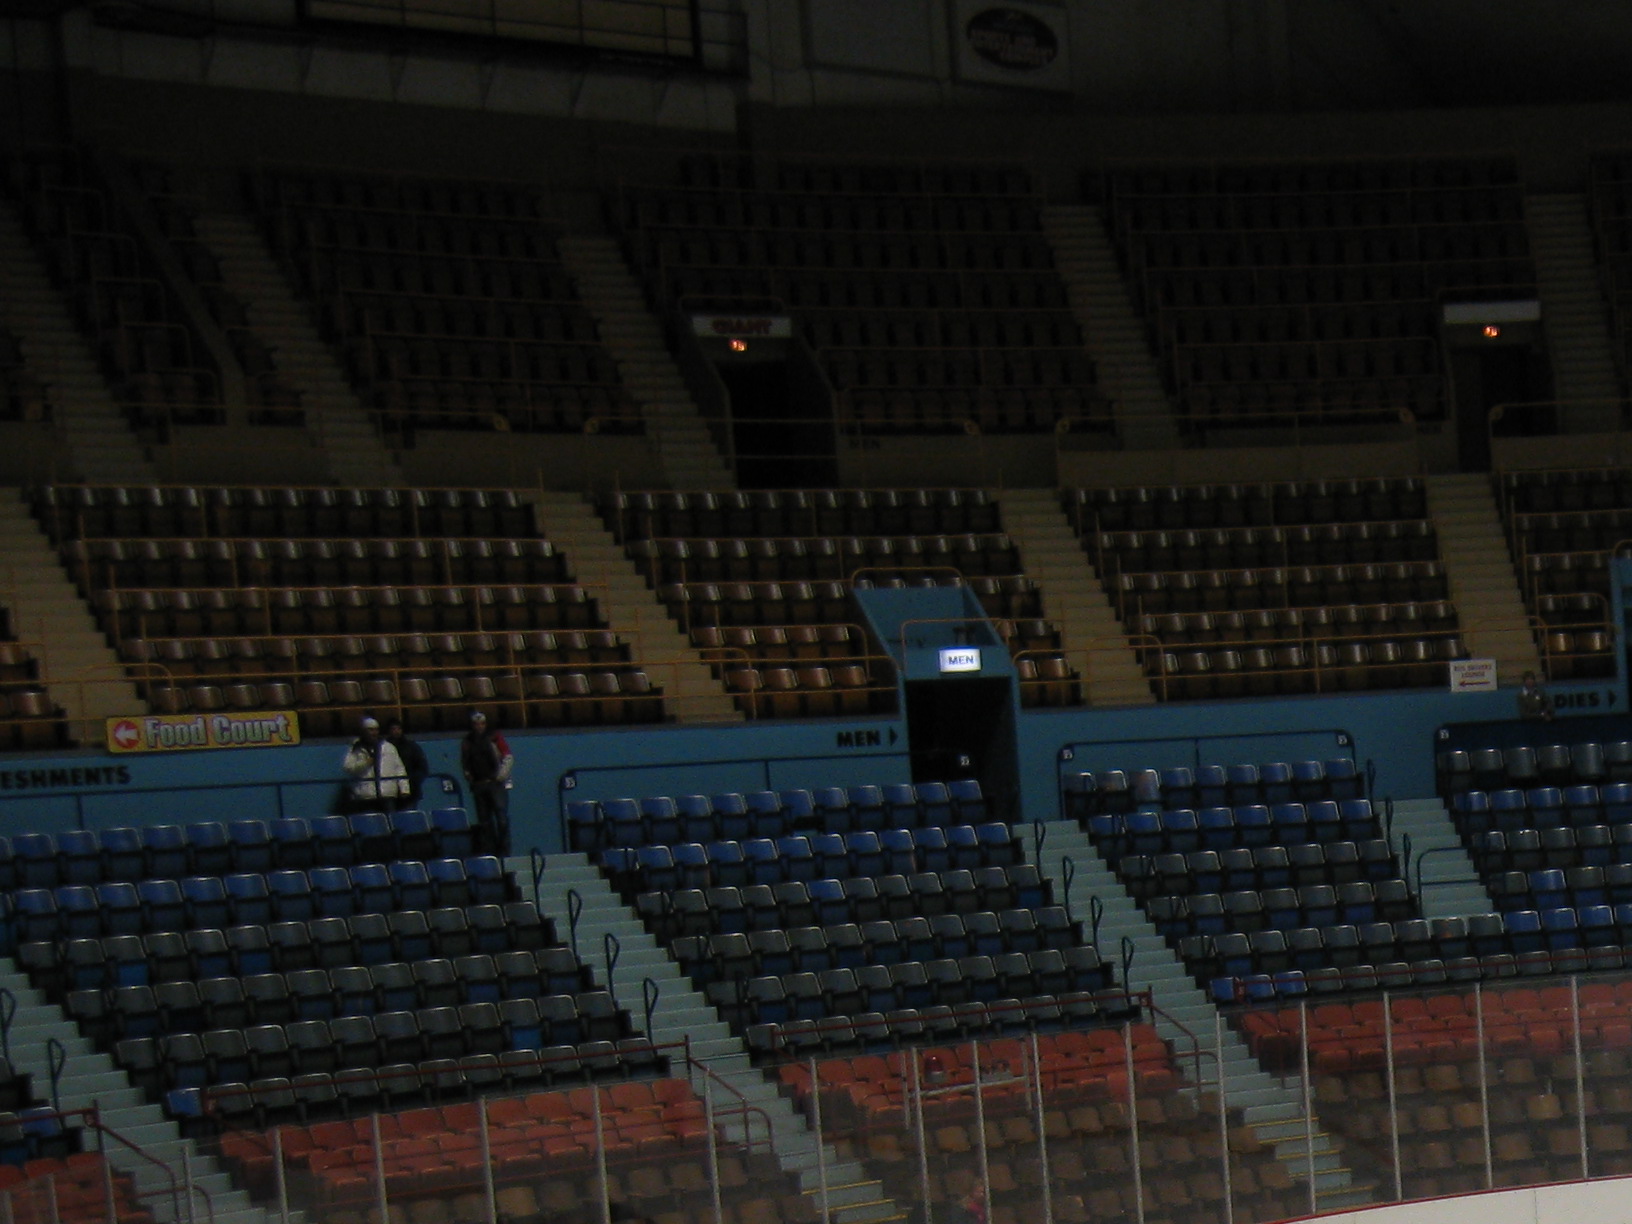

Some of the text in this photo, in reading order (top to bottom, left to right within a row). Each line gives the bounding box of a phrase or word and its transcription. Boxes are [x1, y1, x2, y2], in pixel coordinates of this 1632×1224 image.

[948, 655, 974, 665] MEN
[1554, 692, 1600, 708] DIES
[145, 715, 293, 747] Food Court
[837, 730, 881, 747] MEN
